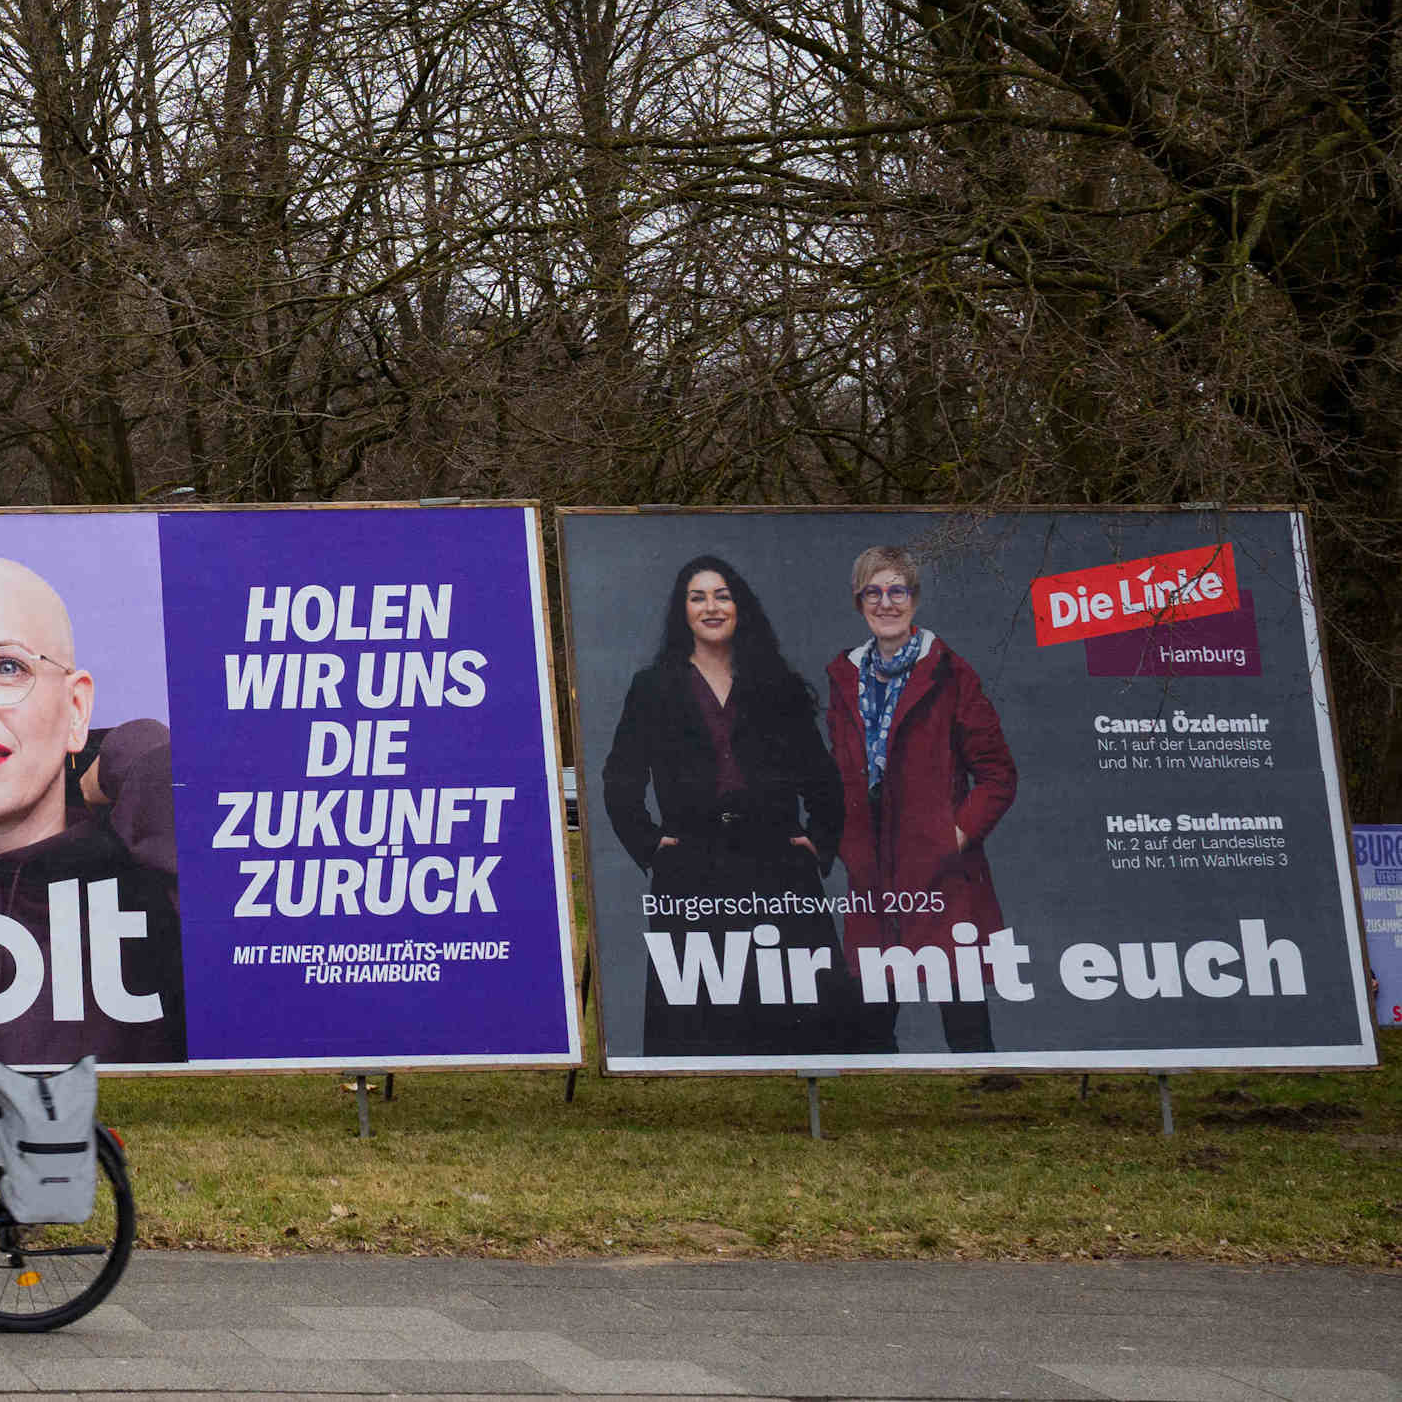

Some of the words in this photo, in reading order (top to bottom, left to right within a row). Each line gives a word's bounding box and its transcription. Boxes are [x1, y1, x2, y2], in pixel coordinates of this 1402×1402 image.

[1049, 585, 1115, 629] Die
[1119, 565, 1224, 615] Linke
[244, 584, 452, 642] HOLEN
[1160, 644, 1247, 666] Hamburg
[225, 652, 341, 710] WIR
[359, 649, 487, 708] UNS
[1095, 715, 1167, 734] Cansu
[1172, 710, 1270, 733] Özdemir
[306, 720, 410, 778] DIE
[1097, 738, 1118, 751] Nr.
[1120, 739, 1128, 750] 1
[1132, 738, 1155, 751] auf
[1159, 738, 1185, 751] der
[1189, 738, 1272, 751] Landesliste
[1099, 756, 1127, 769] und
[1132, 756, 1152, 769] Nr.
[1155, 756, 1163, 768] 1
[1166, 756, 1185, 768] im
[1189, 755, 1261, 768] Wahlkreis
[1264, 755, 1275, 768] 4
[212, 787, 515, 849] ZUKUNFT
[1106, 814, 1172, 833] Heike
[1177, 813, 1284, 832] Sudmann
[1107, 838, 1127, 851] Nr.
[1130, 838, 1141, 851] 2
[1144, 837, 1168, 850] auf
[1172, 837, 1197, 849] der
[1201, 835, 1286, 849] Landesliste
[1112, 855, 1141, 869] und
[1146, 855, 1166, 868] Nr.
[1169, 855, 1177, 868] 1
[1180, 855, 1199, 867] im
[1202, 854, 1275, 867] Wahlkreis
[1279, 853, 1289, 866] 3
[233, 843, 502, 918] ZURÜCK
[642, 891, 876, 920] Bürgerschaftswahl
[883, 892, 945, 914] 2025
[233, 945, 269, 964] MIT
[269, 944, 325, 964] EINER
[327, 939, 510, 963] MOBILITÄTS-WENDE
[644, 923, 831, 1005] Wir
[858, 921, 1034, 1003] mit
[1059, 918, 1308, 999] euch
[305, 961, 343, 984] FÜR
[345, 963, 441, 983] HAMBURG
